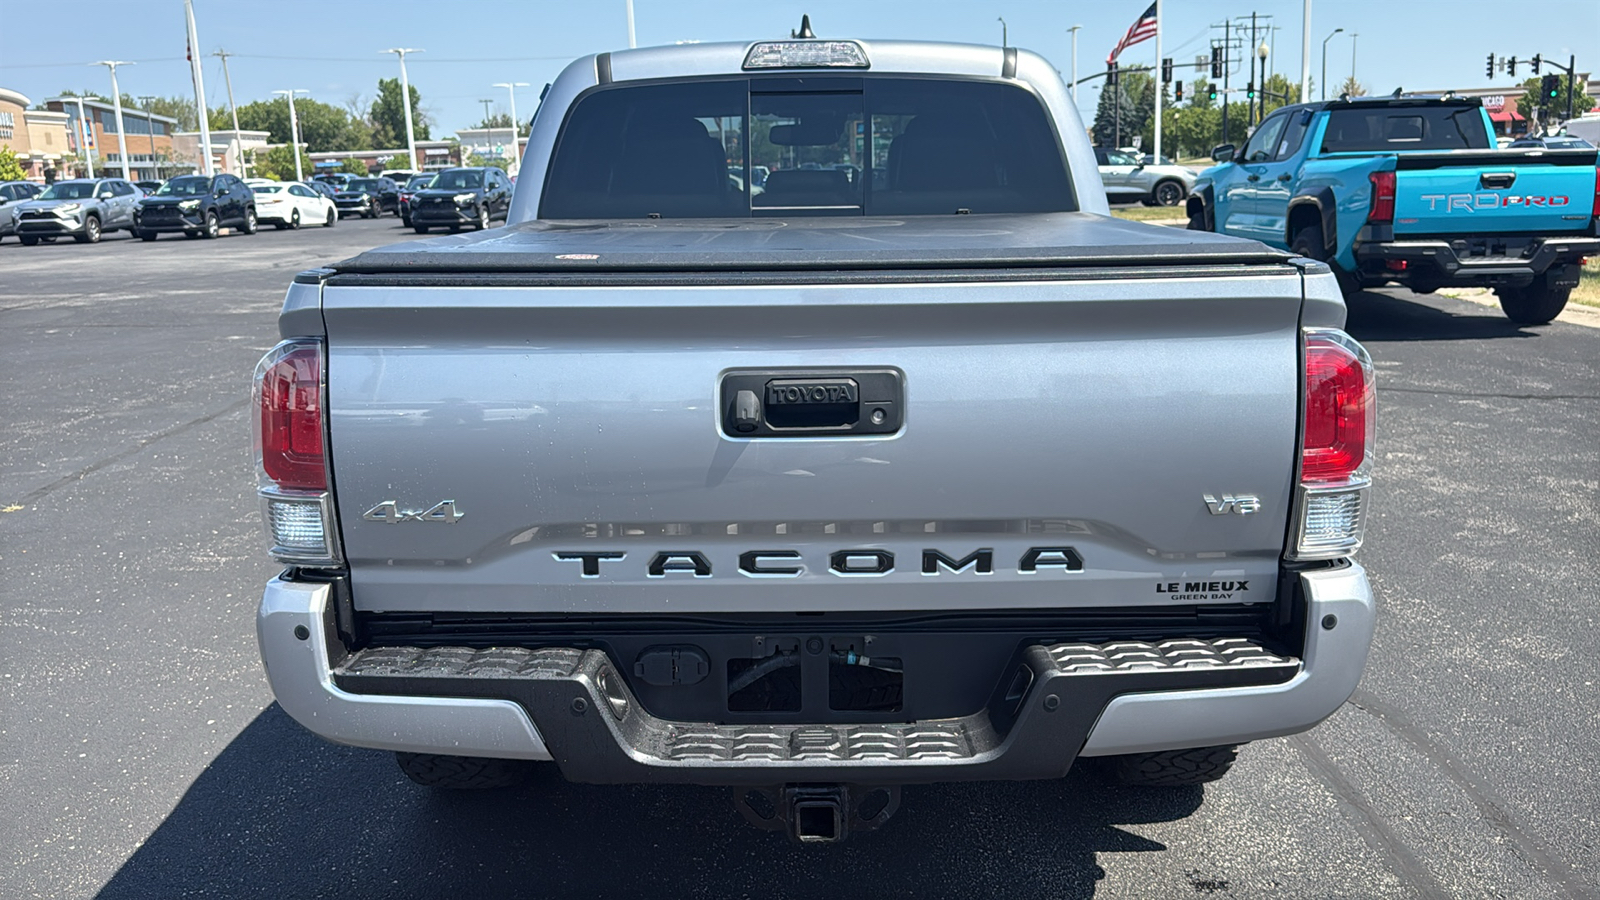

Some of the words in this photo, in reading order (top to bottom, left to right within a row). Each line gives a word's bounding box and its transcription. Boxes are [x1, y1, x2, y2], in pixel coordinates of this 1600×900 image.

[1421, 193, 1500, 213] TRD
[1502, 195, 1569, 207] PRO
[773, 386, 852, 403] TOYOTA
[1203, 494, 1260, 515] V6
[551, 546, 1085, 578] TACOMA
[1156, 583, 1180, 593] LE
[1185, 581, 1249, 592] MIEUX
